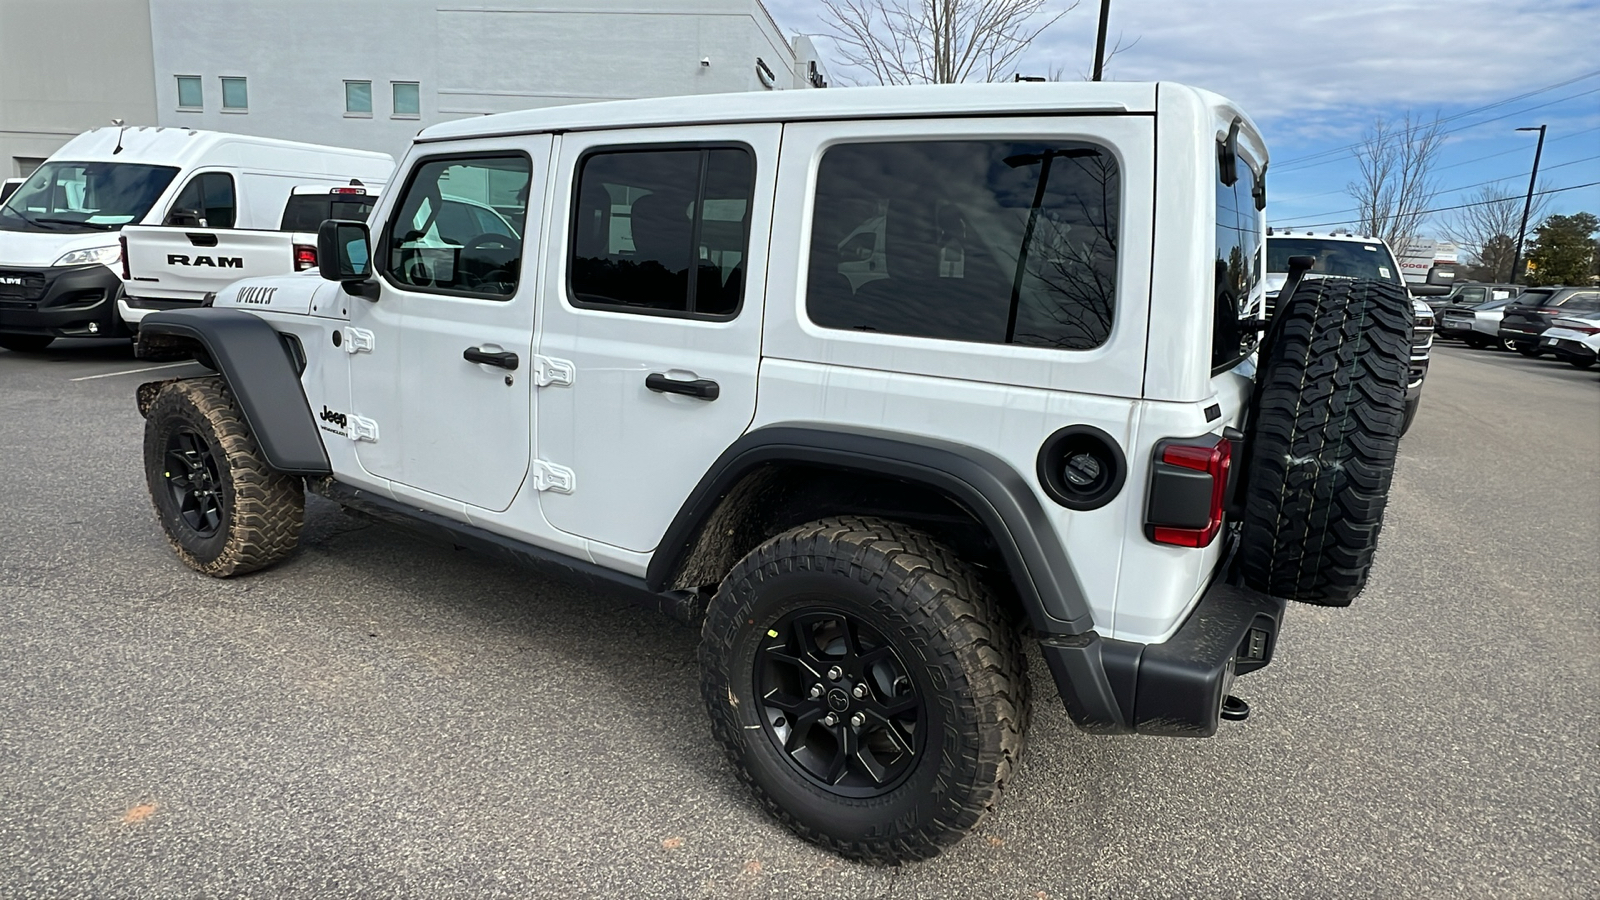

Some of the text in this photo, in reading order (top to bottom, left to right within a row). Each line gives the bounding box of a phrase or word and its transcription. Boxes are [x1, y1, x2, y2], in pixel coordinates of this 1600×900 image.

[167, 254, 243, 268] RAM
[236, 286, 279, 305] WILLYS
[319, 404, 347, 429] Jeep
[870, 598, 959, 802] WILDPEAK
